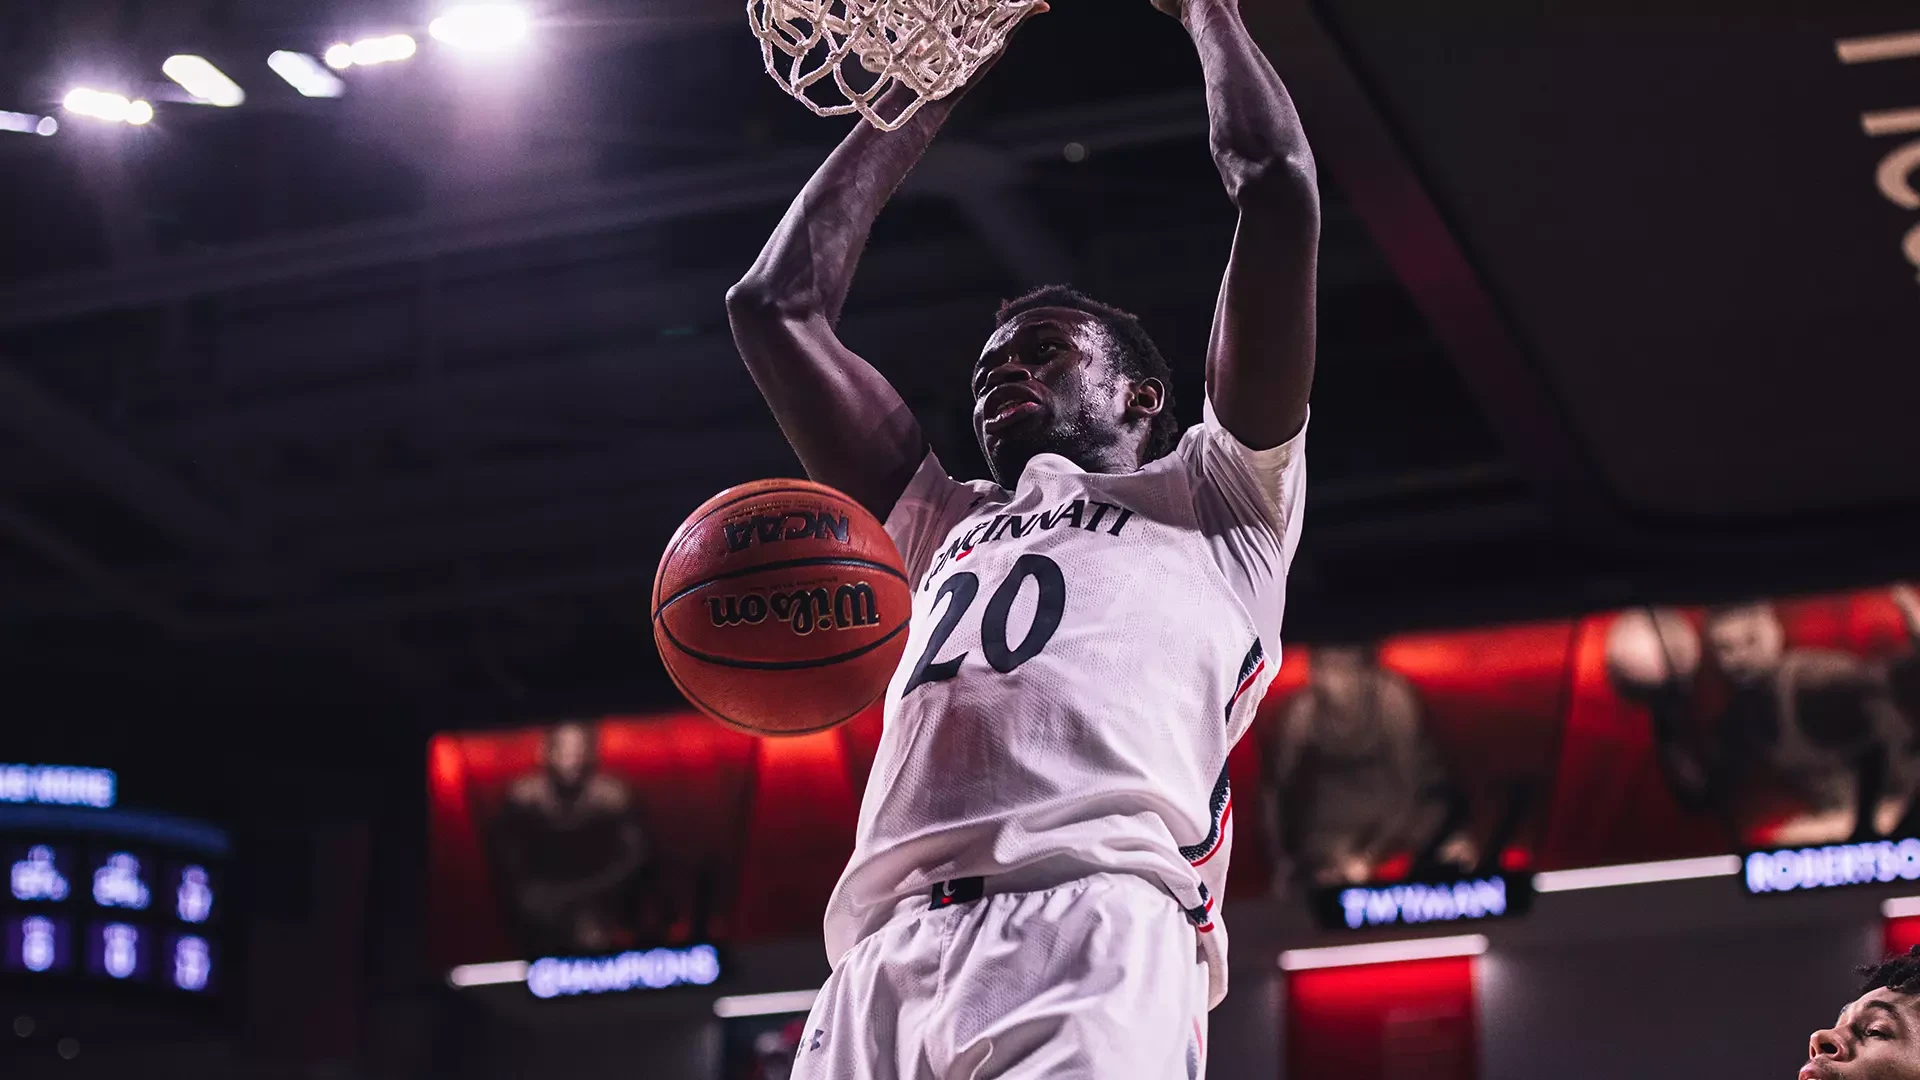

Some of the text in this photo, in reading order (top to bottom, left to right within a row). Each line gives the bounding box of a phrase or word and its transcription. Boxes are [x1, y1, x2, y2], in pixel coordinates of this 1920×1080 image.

[723, 511, 849, 551] NCAA
[706, 581, 880, 636] Wilson
[901, 554, 1066, 699] 20
